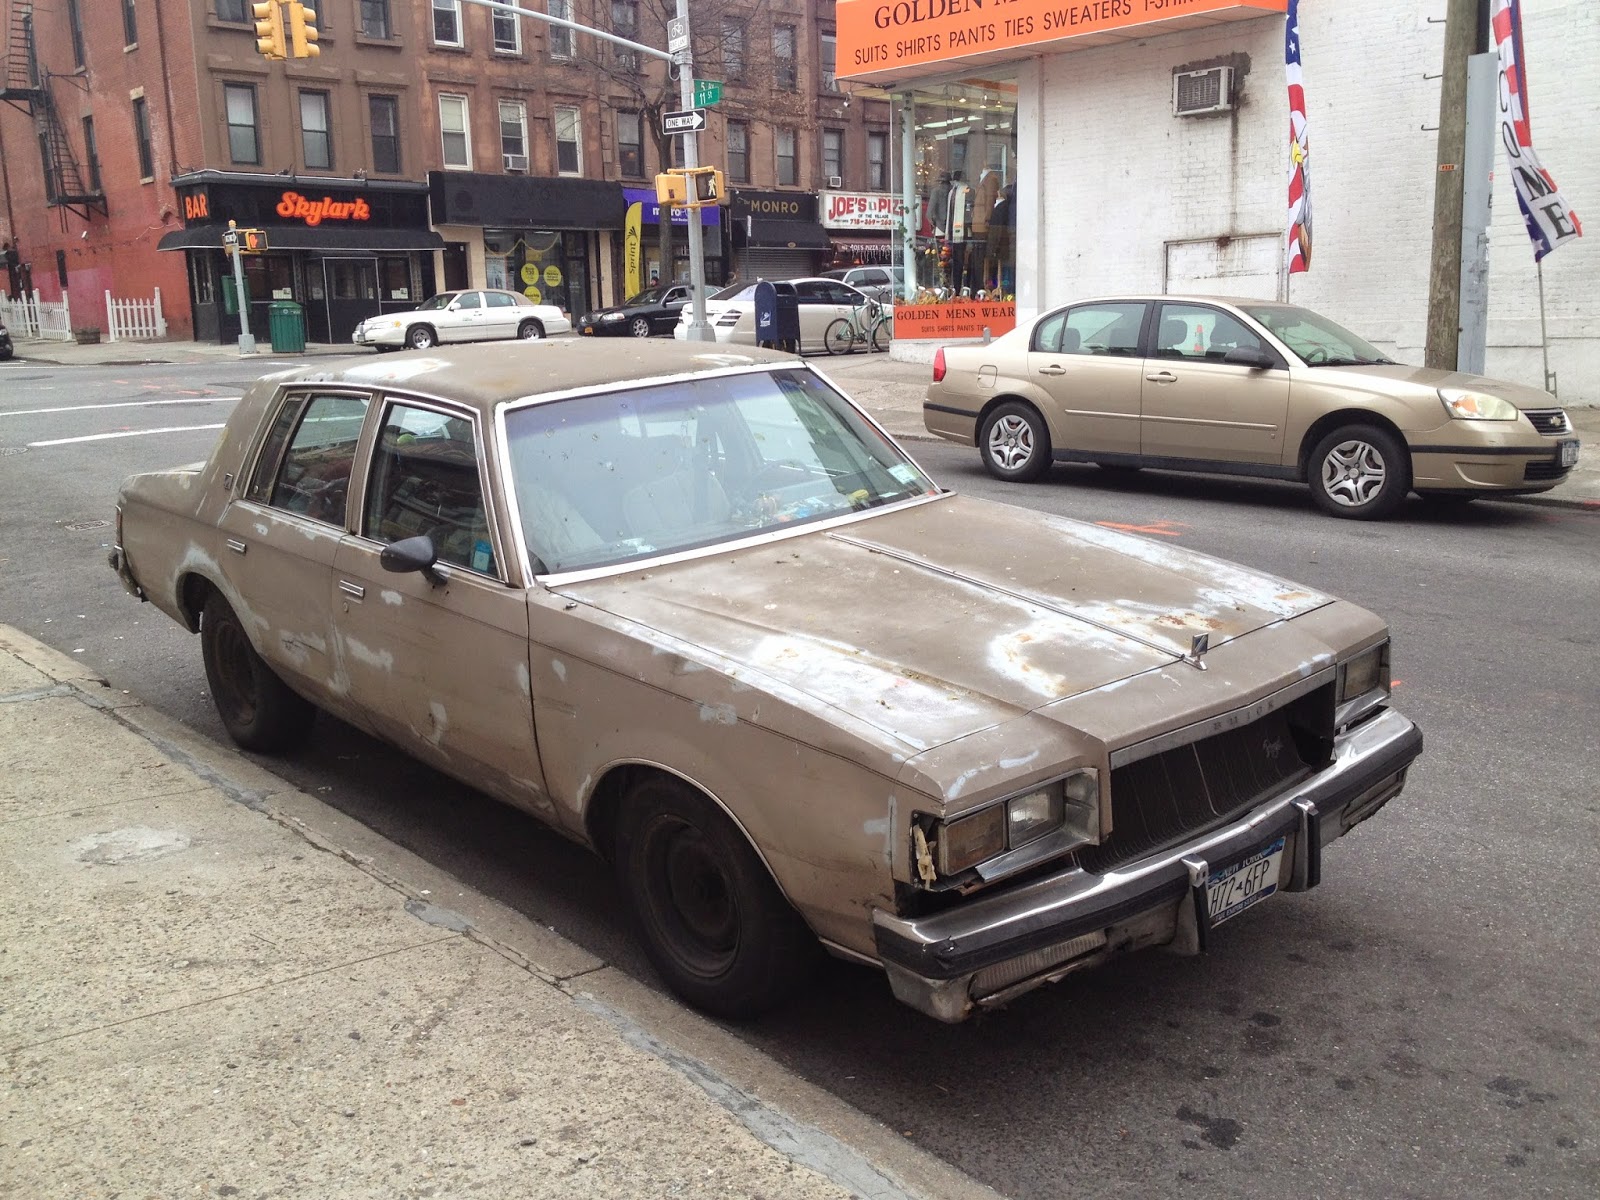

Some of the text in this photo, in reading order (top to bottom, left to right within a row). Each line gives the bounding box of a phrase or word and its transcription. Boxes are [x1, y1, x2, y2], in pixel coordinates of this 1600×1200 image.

[874, 0, 983, 29] GOLDEN
[855, 44, 888, 65] SUITS
[896, 34, 941, 58] SHIRTS
[949, 23, 996, 48] PANTS
[1004, 16, 1034, 38] TIES
[1043, 0, 1132, 30] SWEATERS
[701, 82, 706, 91] 5
[699, 91, 713, 105] 11 St
[667, 117, 694, 127] ONE WAY
[185, 193, 208, 220] BAR
[276, 191, 370, 226] Skylark
[751, 199, 799, 214] MONRO
[828, 197, 904, 220] JOE'S PIZ
[629, 242, 637, 274] Sprint
[896, 306, 1016, 321] GOLDEN MENS WEAR
[921, 325, 934, 333] SUITS
[957, 324, 974, 332] PANTS
